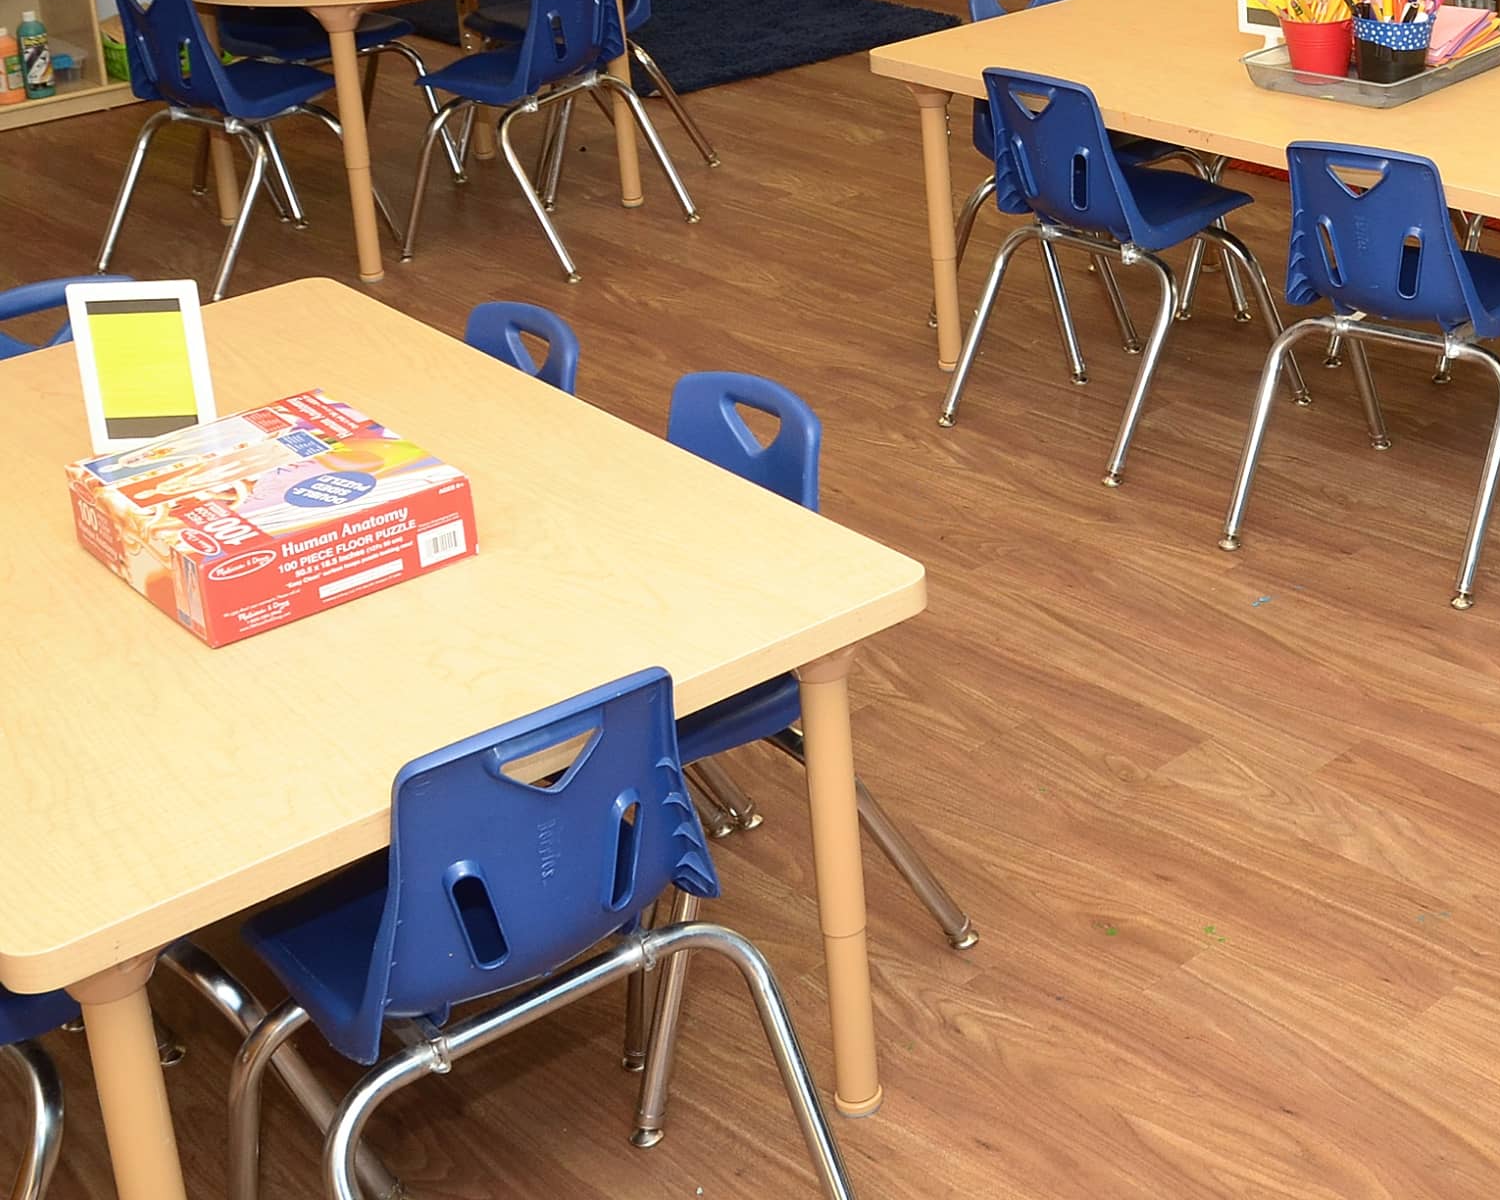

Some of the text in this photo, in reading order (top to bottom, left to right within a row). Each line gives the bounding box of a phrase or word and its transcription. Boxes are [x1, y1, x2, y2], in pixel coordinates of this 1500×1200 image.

[311, 482, 352, 497] SIDED
[79, 503, 98, 530] 100
[203, 517, 259, 546] 100
[282, 531, 338, 558] Human
[342, 507, 409, 538] Anatomy
[278, 560, 297, 575] 100
[300, 549, 334, 567] PIECE
[336, 534, 373, 554] FLOOR
[376, 519, 417, 542] PUZZLE
